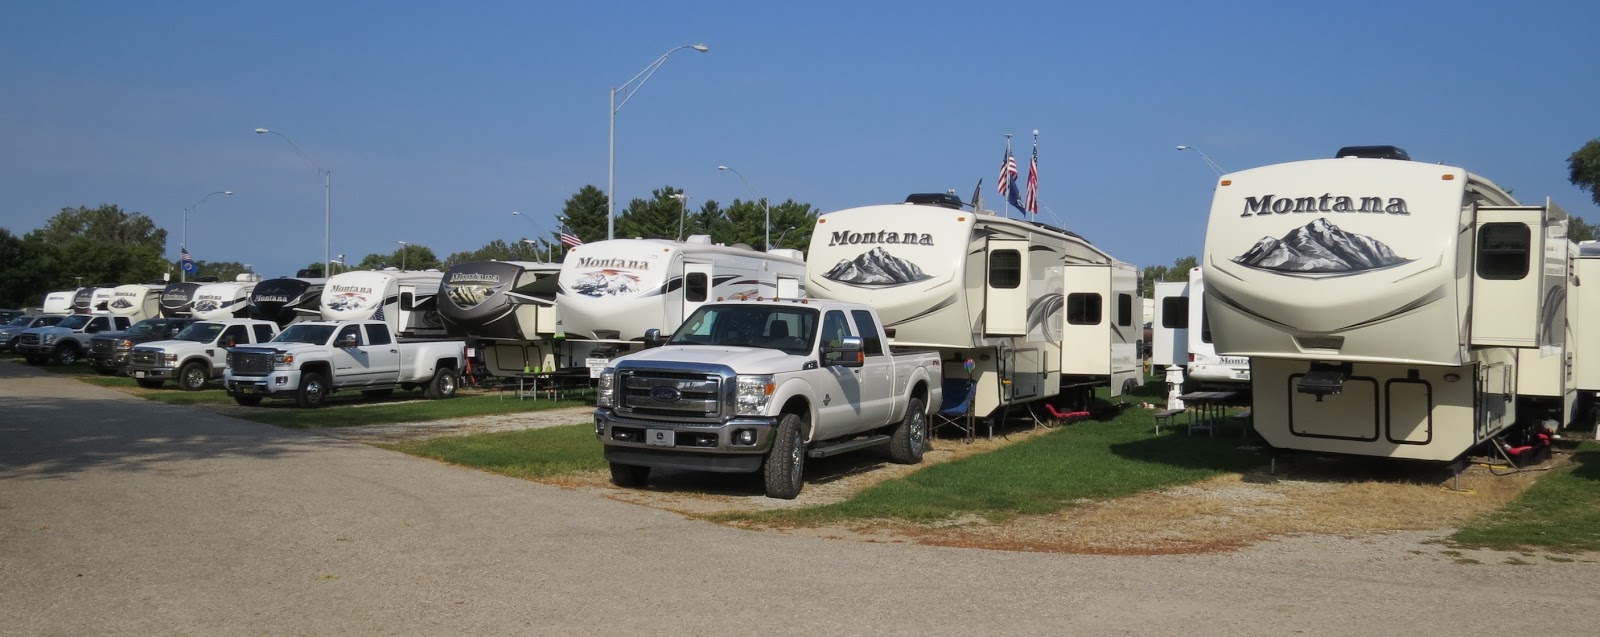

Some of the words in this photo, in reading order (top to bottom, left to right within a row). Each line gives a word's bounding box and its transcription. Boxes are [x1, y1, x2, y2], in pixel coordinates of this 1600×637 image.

[1240, 192, 1411, 218] Montana
[828, 229, 935, 246] Montana
[576, 256, 649, 270] Montana
[449, 272, 500, 283] Montana
[330, 284, 372, 294] Montana
[255, 294, 288, 303] Montana
